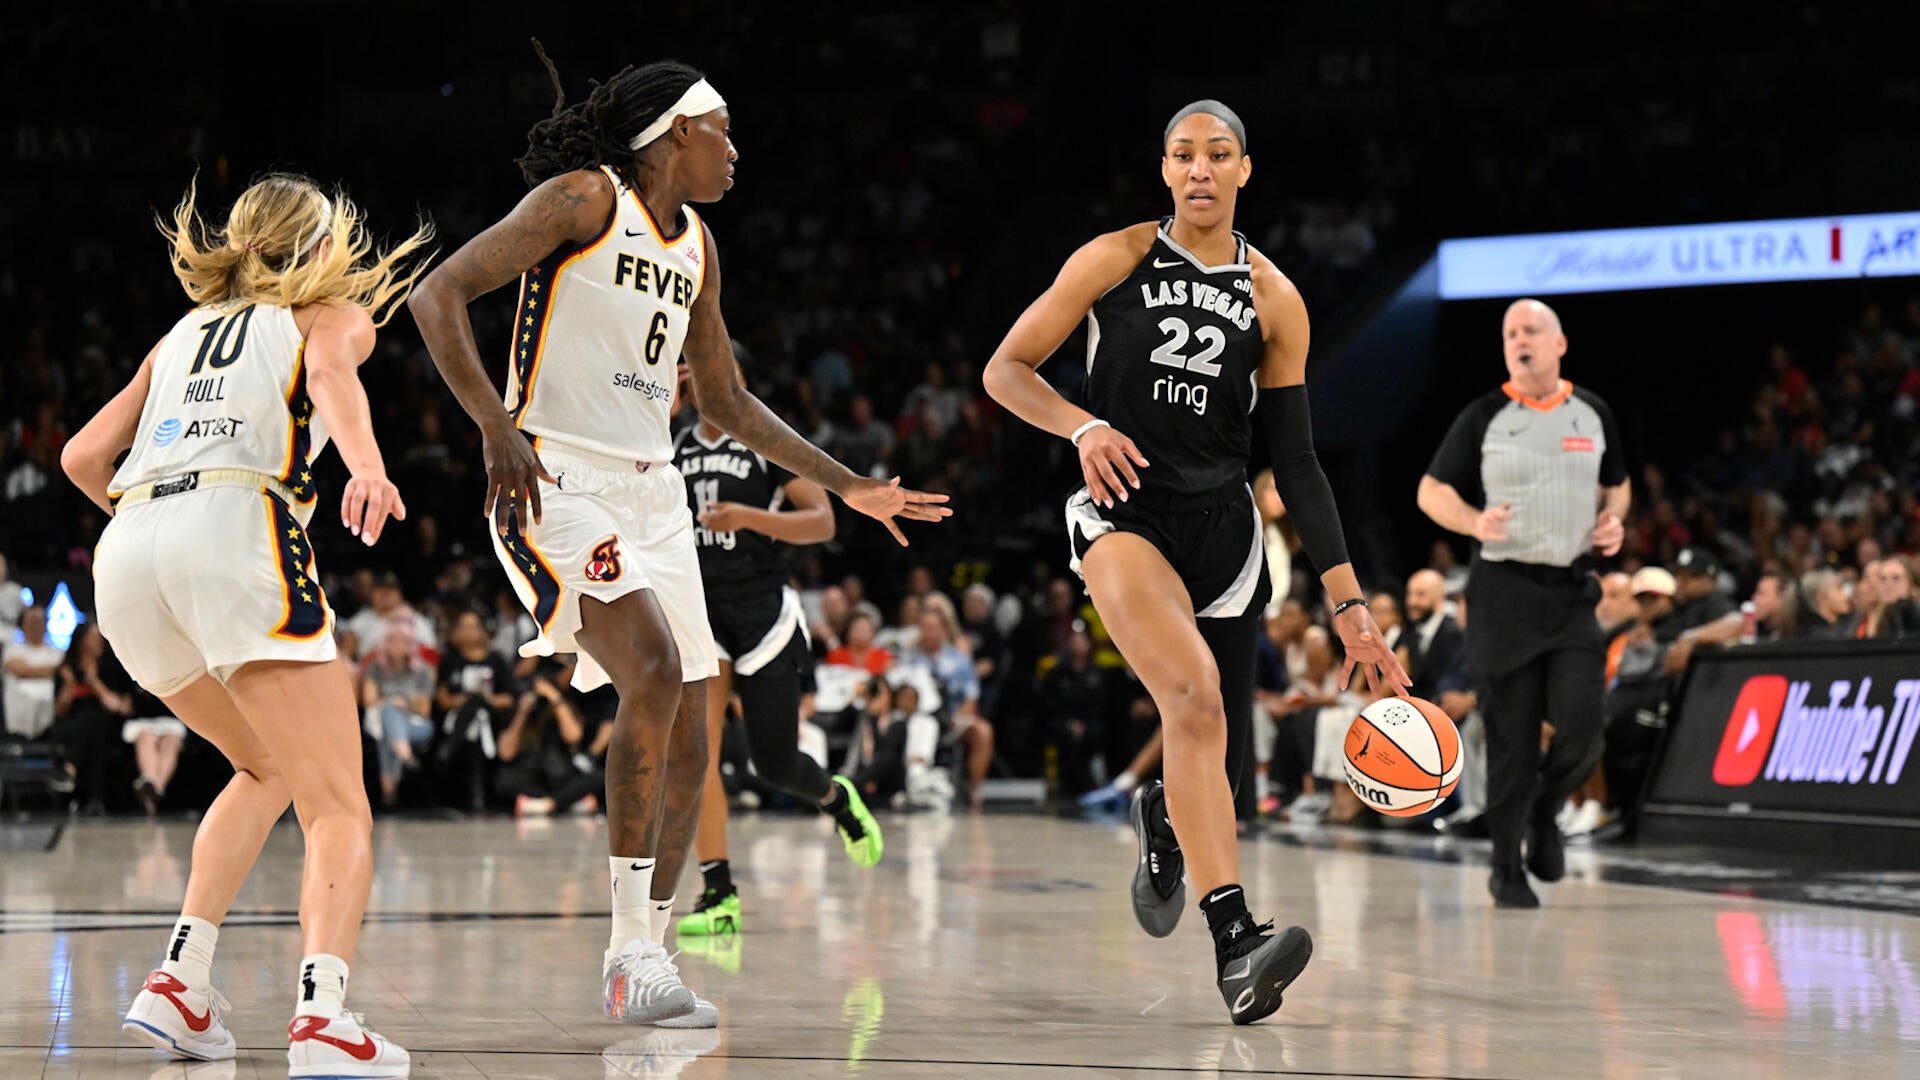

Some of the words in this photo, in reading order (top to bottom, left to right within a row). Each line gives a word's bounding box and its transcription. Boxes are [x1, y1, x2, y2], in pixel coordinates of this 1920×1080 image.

[1670, 231, 1808, 274] ULTRA
[614, 253, 694, 310] FEVER
[1141, 280, 1188, 309] LAS
[1192, 281, 1256, 332] VEGAS
[189, 303, 256, 376] 10
[644, 310, 669, 367] 6
[1150, 316, 1226, 378] 22
[184, 376, 225, 405] HULL
[1153, 375, 1208, 416] ring
[184, 418, 243, 439] AT&T
[681, 455, 702, 477] AS
[693, 478, 720, 518] 11
[1764, 676, 1885, 785] YouTube
[1868, 679, 1920, 785] TV
